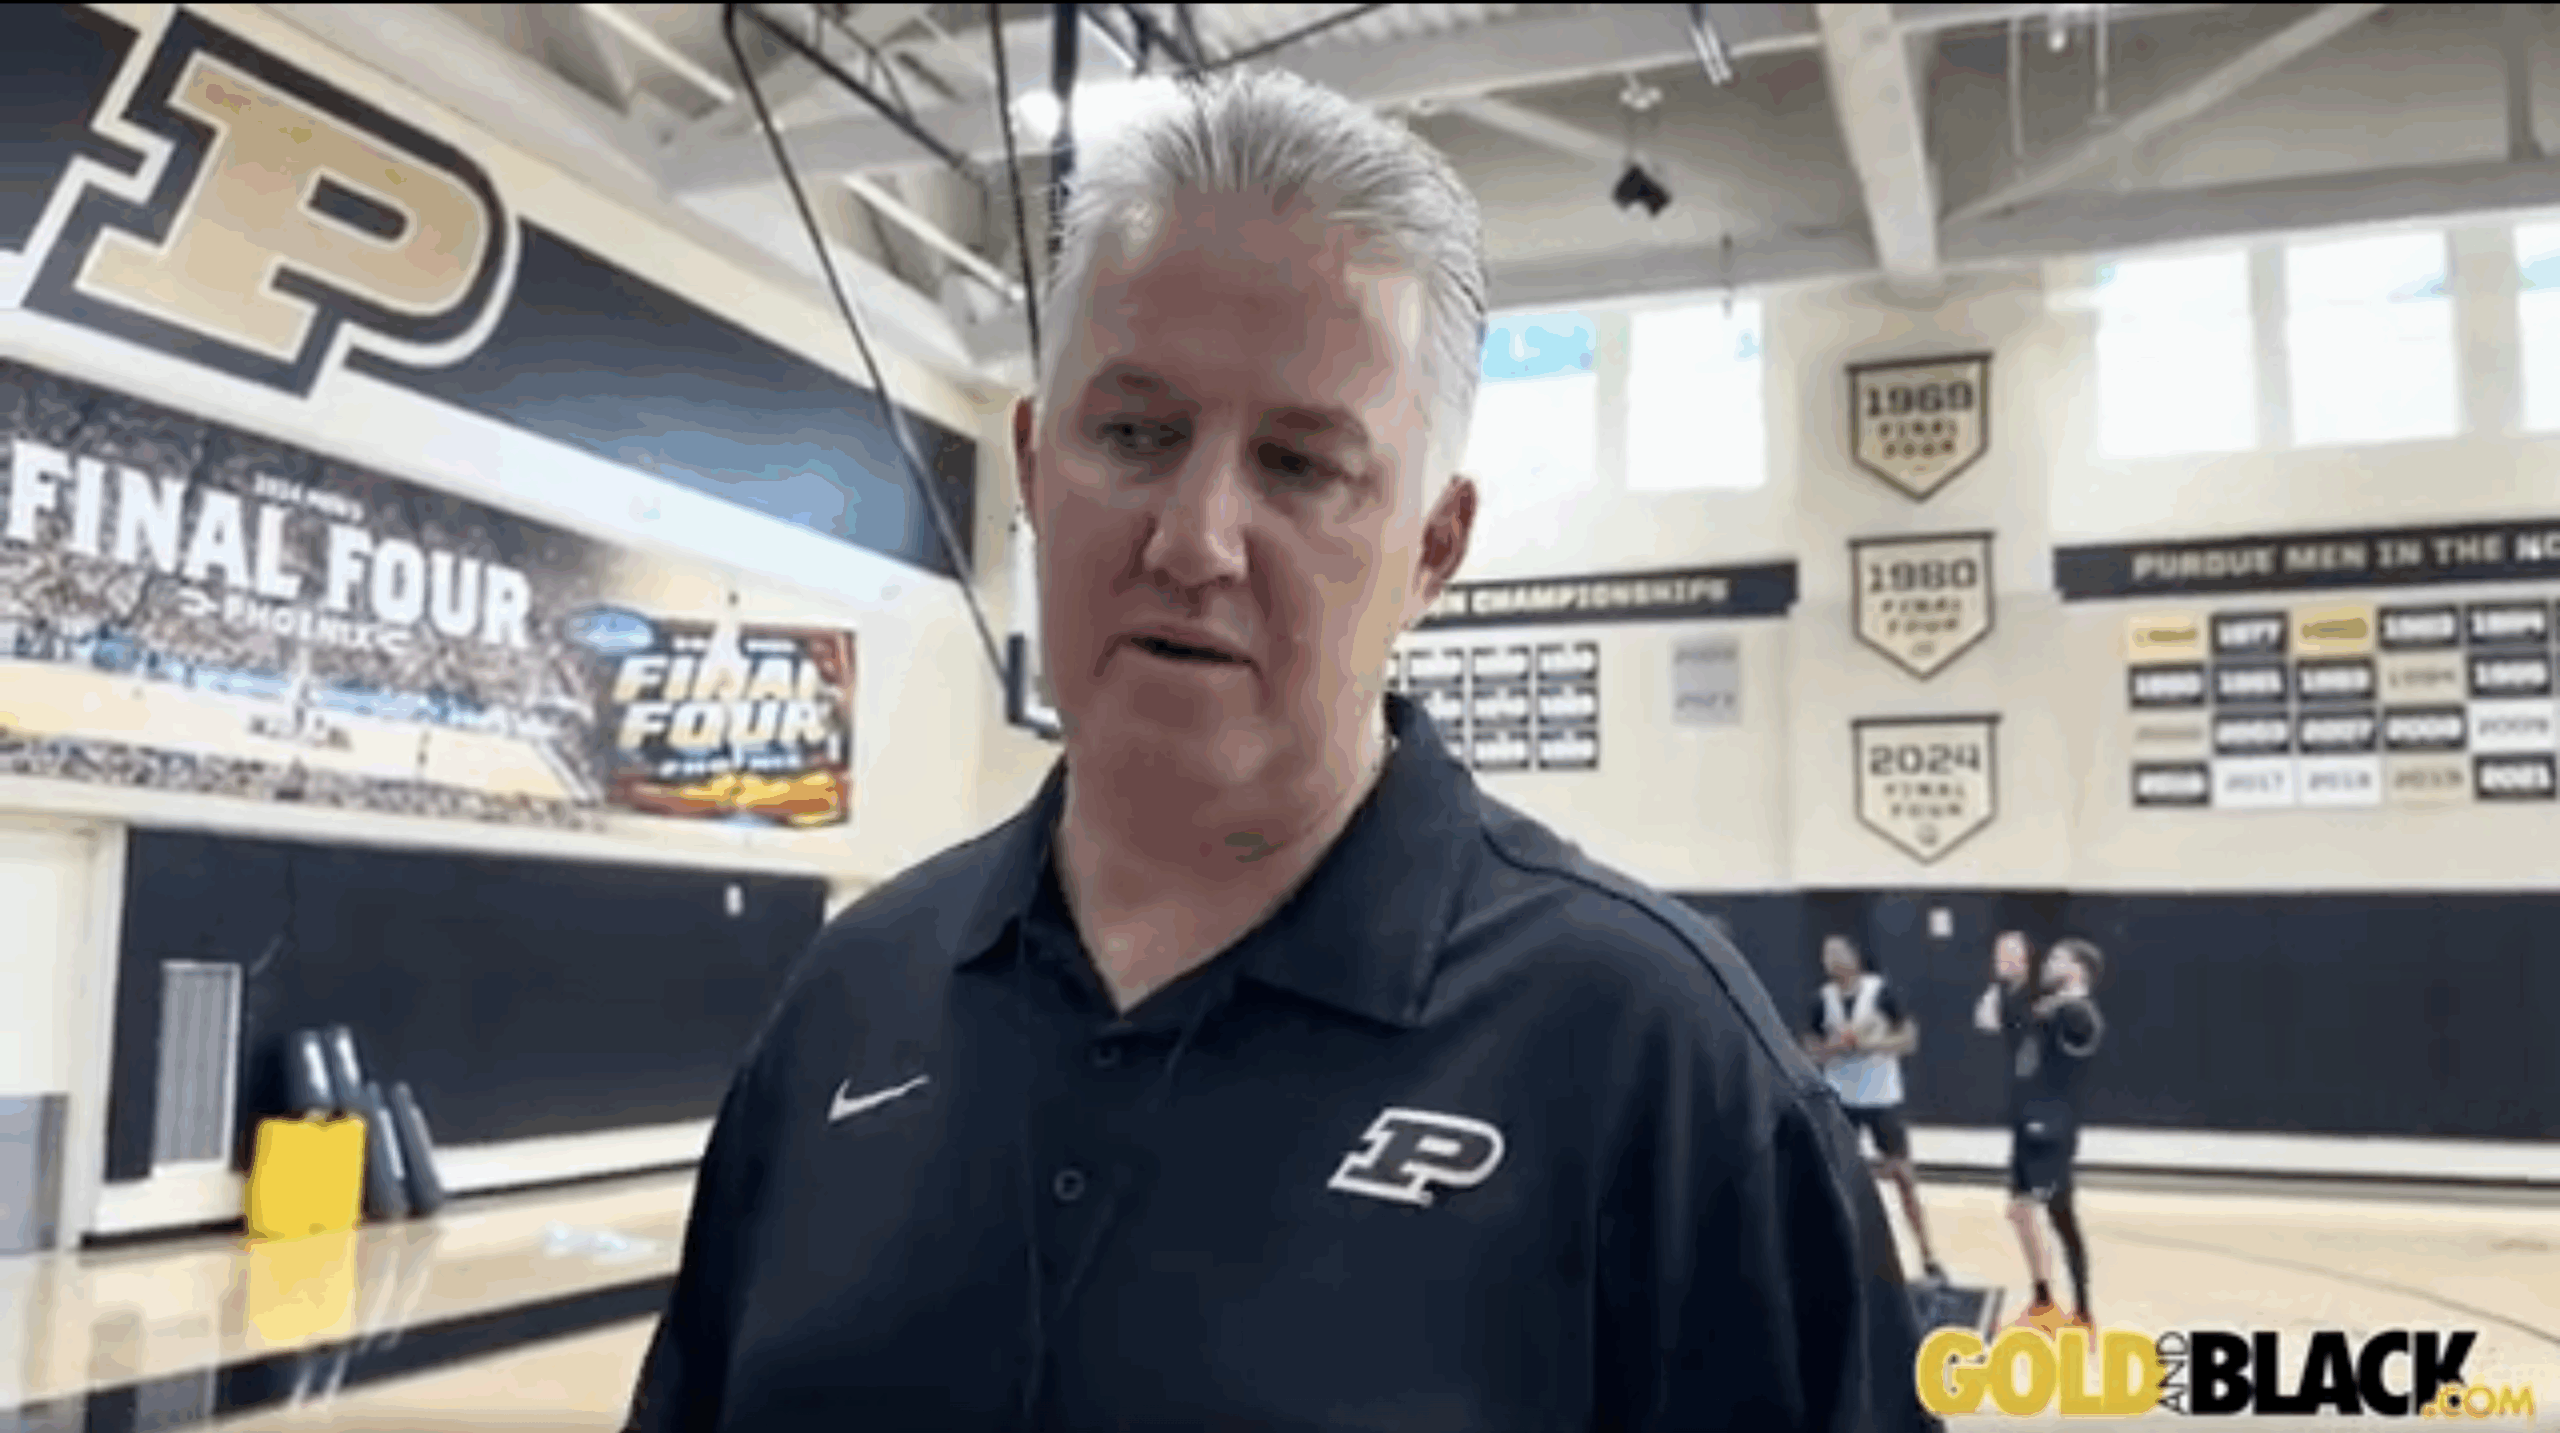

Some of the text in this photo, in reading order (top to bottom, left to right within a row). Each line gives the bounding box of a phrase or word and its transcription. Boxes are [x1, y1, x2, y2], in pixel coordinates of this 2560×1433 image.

[40, 20, 508, 388] P
[5, 438, 532, 647] FINAL FOUR
[2132, 548, 2276, 581] PURDUE
[2286, 543, 2368, 571] MEN
[2378, 539, 2423, 566] IN
[2432, 533, 2504, 565] THE
[1471, 579, 1728, 615] CHAMPIONSHIPS
[1869, 742, 1980, 776] 2024
[1327, 1106, 1506, 1207] P
